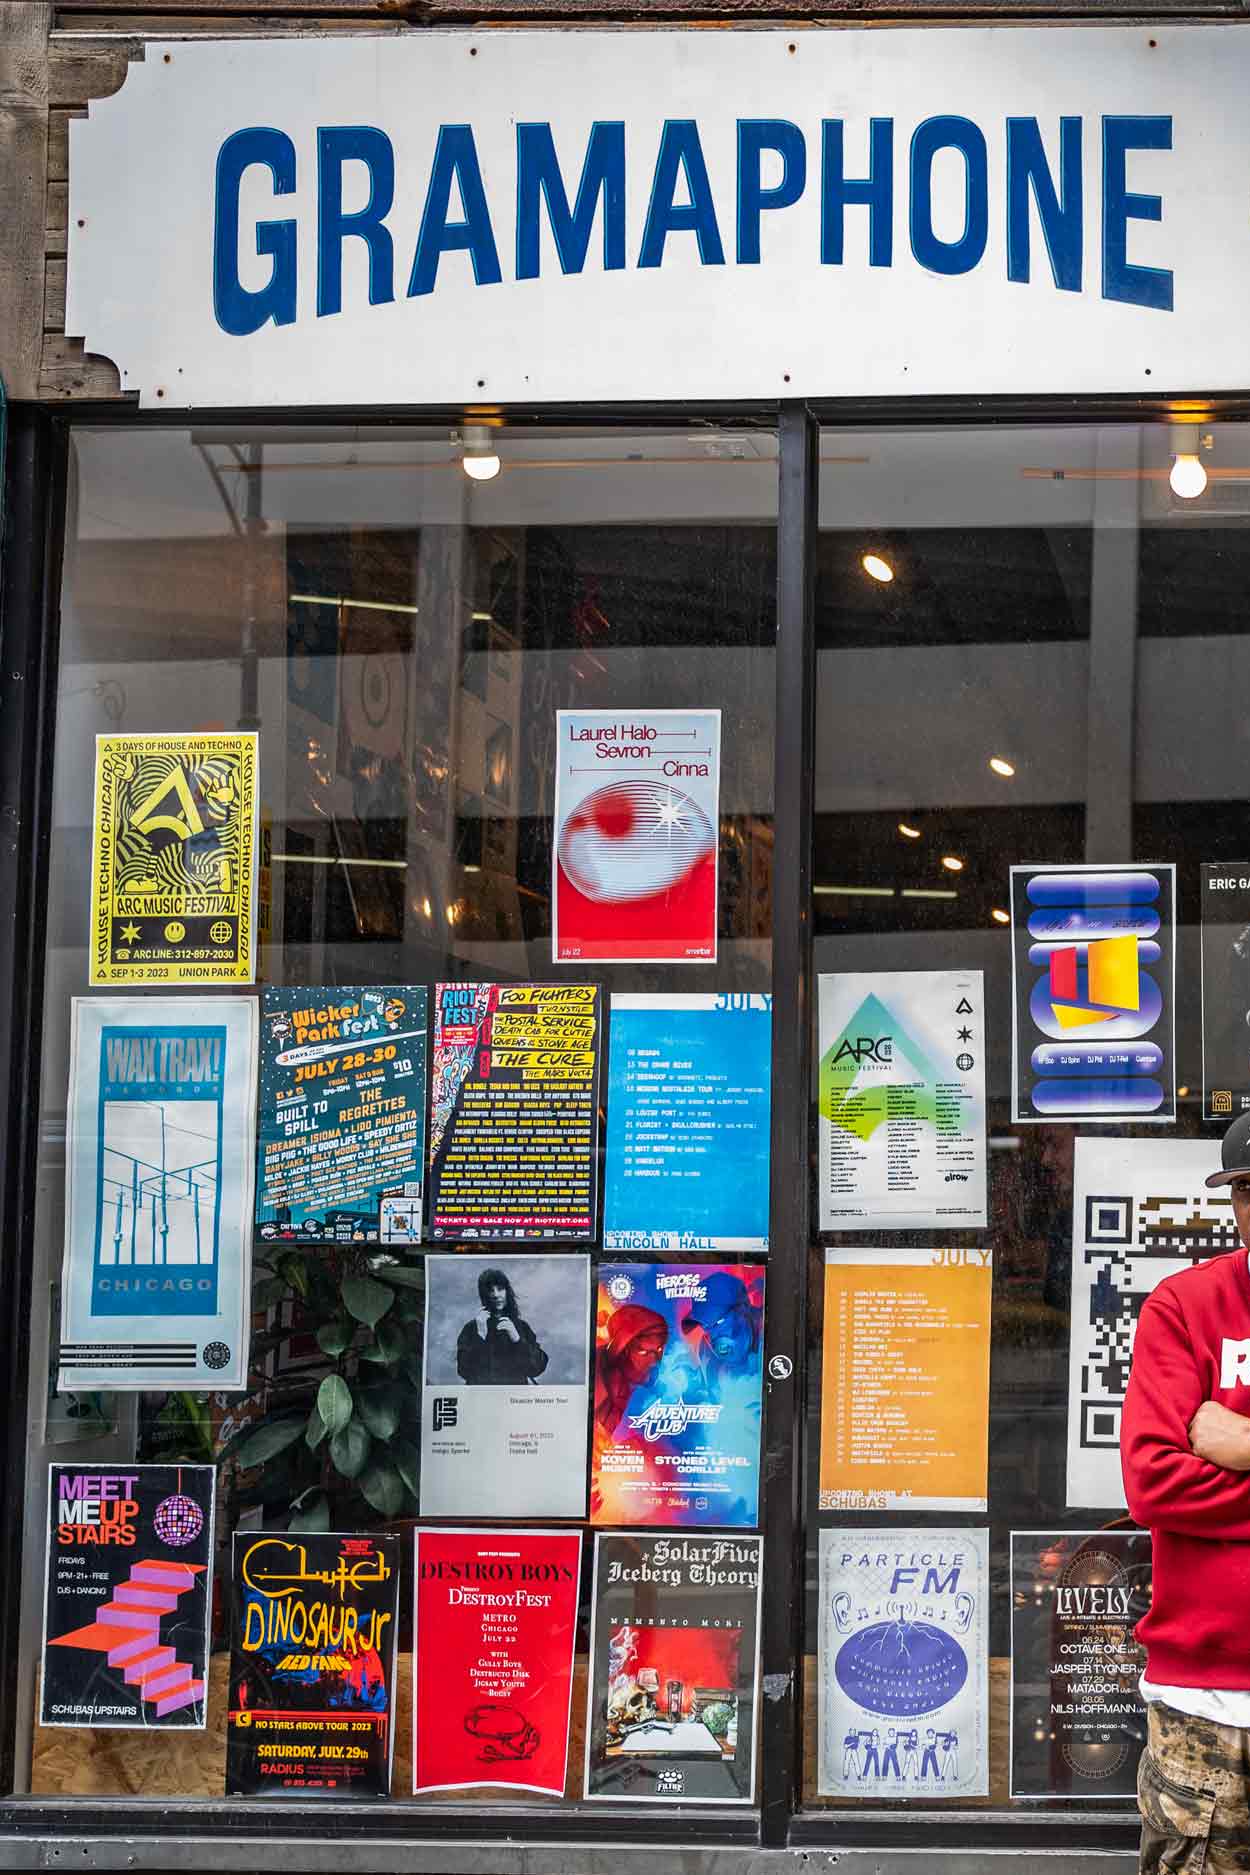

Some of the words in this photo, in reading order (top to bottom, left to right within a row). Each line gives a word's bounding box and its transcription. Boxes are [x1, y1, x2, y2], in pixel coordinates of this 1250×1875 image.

[213, 115, 1173, 336] GRAMAPHONE
[570, 725, 617, 741] Laurel
[620, 725, 657, 740] Halo
[116, 743, 121, 751] 3
[122, 742, 144, 751] DAYS
[145, 742, 156, 750] OF
[158, 742, 187, 750] HOUSE
[208, 741, 242, 749] TECHNO
[595, 742, 651, 758] Sevron
[663, 761, 708, 777] Cinna
[243, 755, 253, 810] HOUSE
[101, 759, 114, 836] CHICAGO
[242, 812, 252, 880] TECHNO
[99, 838, 111, 904] TECHNO
[1209, 879, 1236, 890] ERIC
[117, 898, 142, 914] ARC
[144, 898, 182, 914] MUSIC
[184, 896, 237, 913] FESTIVAL
[240, 885, 250, 960] CHICAGO
[98, 907, 109, 964] HOUSE
[134, 950, 151, 959] ARC
[153, 950, 174, 959] LINE:
[175, 949, 234, 959] 312-897-2030
[111, 968, 127, 977] SEP
[130, 968, 144, 977] 1-3
[147, 968, 168, 977] 2023
[179, 968, 209, 977] UNION
[211, 968, 237, 977] PARK
[442, 990, 476, 1008] RIOT
[502, 992, 526, 1003] FOO
[529, 989, 592, 1002] FIGHTERS
[291, 1003, 360, 1028] Wicker
[444, 1008, 478, 1024] FEST
[296, 1024, 340, 1044] Park
[832, 1037, 893, 1063] ARC
[105, 1037, 158, 1083] WAX
[159, 1037, 221, 1083] TRAX!
[498, 1054, 528, 1065] THE
[539, 1053, 586, 1065] CURE
[359, 1087, 383, 1103] THE
[276, 1104, 309, 1124] BUILT
[313, 1100, 328, 1115] TO
[339, 1096, 406, 1122] REGRETTES
[284, 1118, 319, 1136] SPILL
[945, 1174, 968, 1182] elrow
[604, 1238, 670, 1249] LINCOLN
[679, 1238, 716, 1249] HALL
[932, 1249, 990, 1265] JULY
[98, 1278, 213, 1292] CHICAGO
[602, 1455, 644, 1465] KOVEN
[655, 1455, 708, 1465] STONED
[711, 1456, 750, 1465] LEVEL
[59, 1475, 139, 1500] MEET
[820, 1498, 887, 1509] SCHUBAS
[58, 1525, 137, 1545] STAIRS
[653, 1540, 759, 1565] SolarFive
[840, 1553, 965, 1566] PARTICLE
[608, 1562, 681, 1586] Iceberg
[689, 1564, 759, 1588] Theory
[890, 1568, 961, 1594] FM
[1056, 1587, 1135, 1615] LIVELY
[243, 1597, 358, 1655] DINOSAUR
[359, 1609, 391, 1651] Jr
[1060, 1645, 1101, 1654] OCTAVE
[1104, 1645, 1127, 1654] ONE
[1068, 1684, 1119, 1694] MATADOR
[52, 1705, 94, 1714] SCHUBAS
[94, 1706, 136, 1716] UPSTAIRS
[1051, 1704, 1073, 1713] NILS
[1075, 1704, 1136, 1713] HOFFMANN
[258, 1744, 316, 1758] SATURDAY,
[261, 1763, 304, 1774] RADIUS
